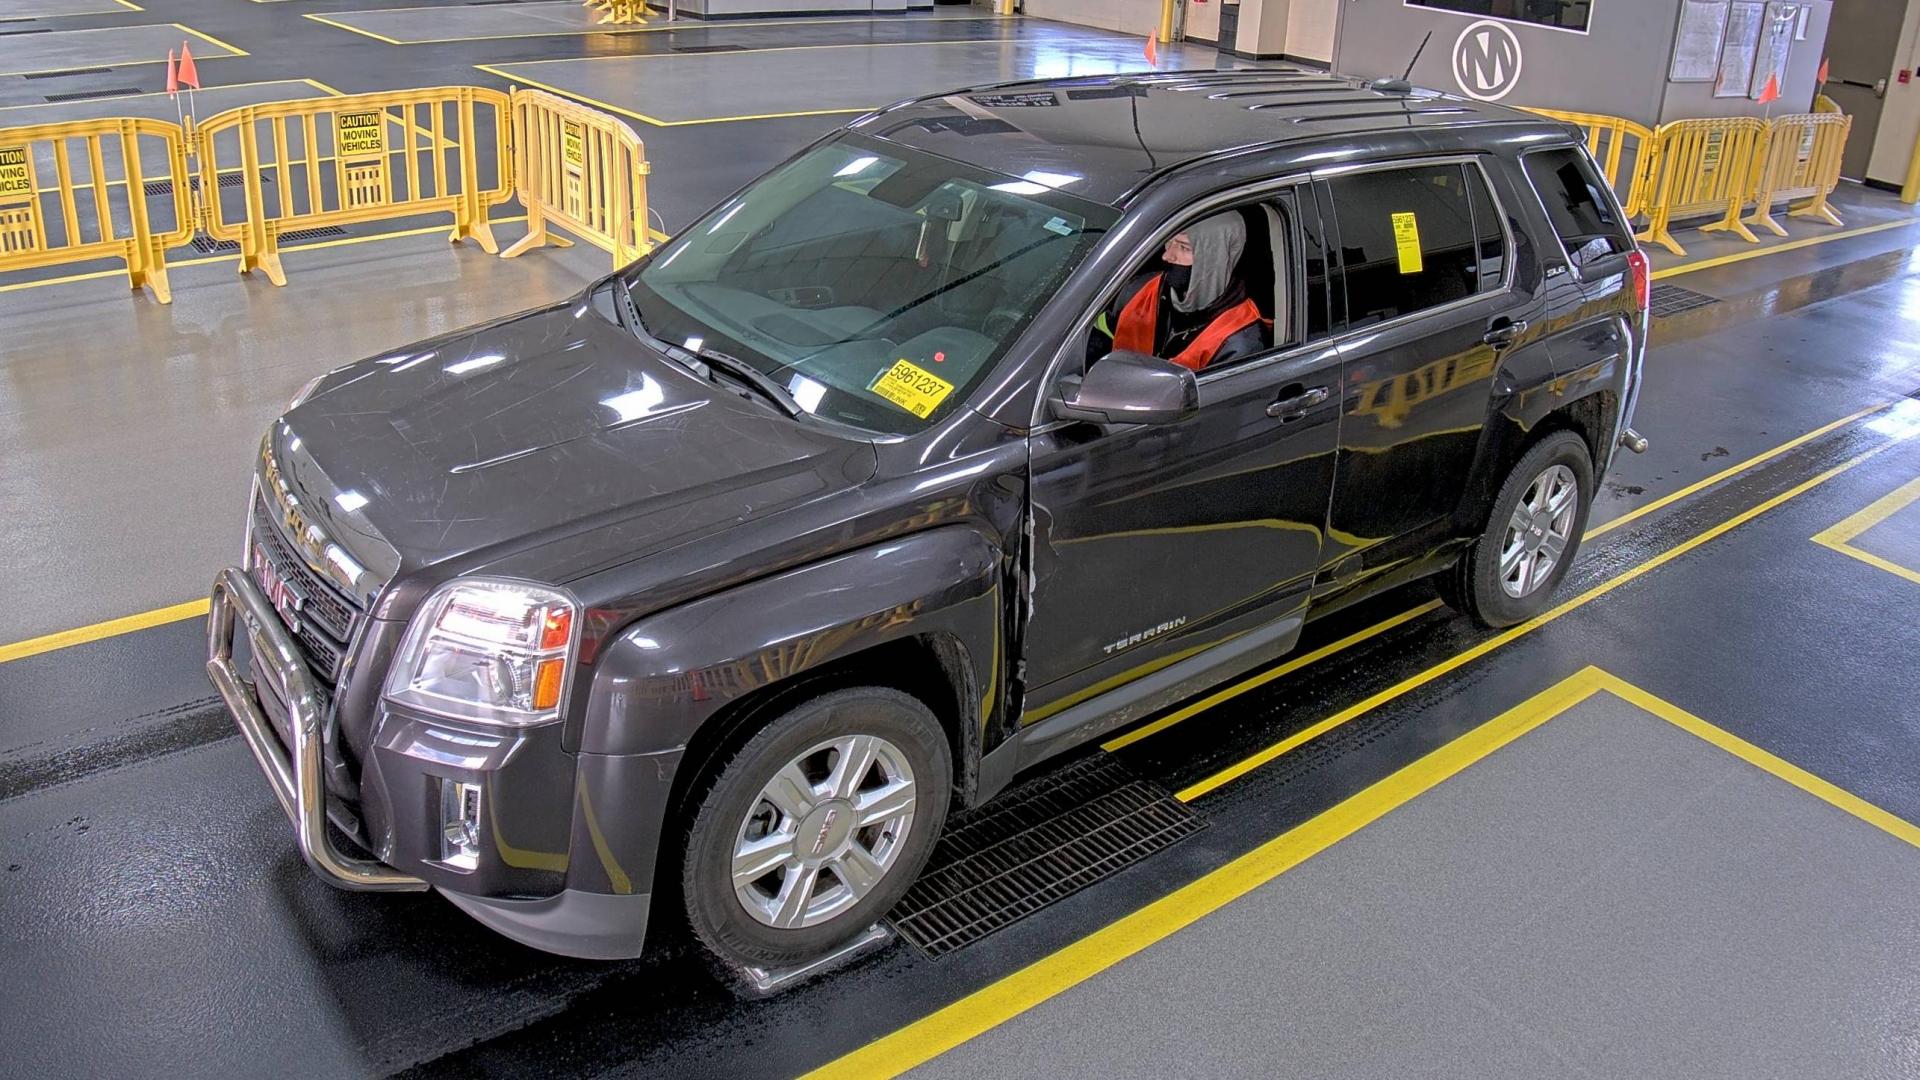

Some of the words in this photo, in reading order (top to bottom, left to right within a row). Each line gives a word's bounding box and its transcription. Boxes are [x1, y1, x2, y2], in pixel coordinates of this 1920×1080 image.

[341, 114, 379, 128] CAUTION
[342, 140, 381, 151] VEHICLES
[344, 129, 377, 141] MOVING
[0, 179, 30, 192] ICLES
[889, 364, 945, 397] 5961237
[254, 542, 305, 633] GMC
[1103, 615, 1186, 654] TERRAIN
[811, 809, 837, 854] GMC
